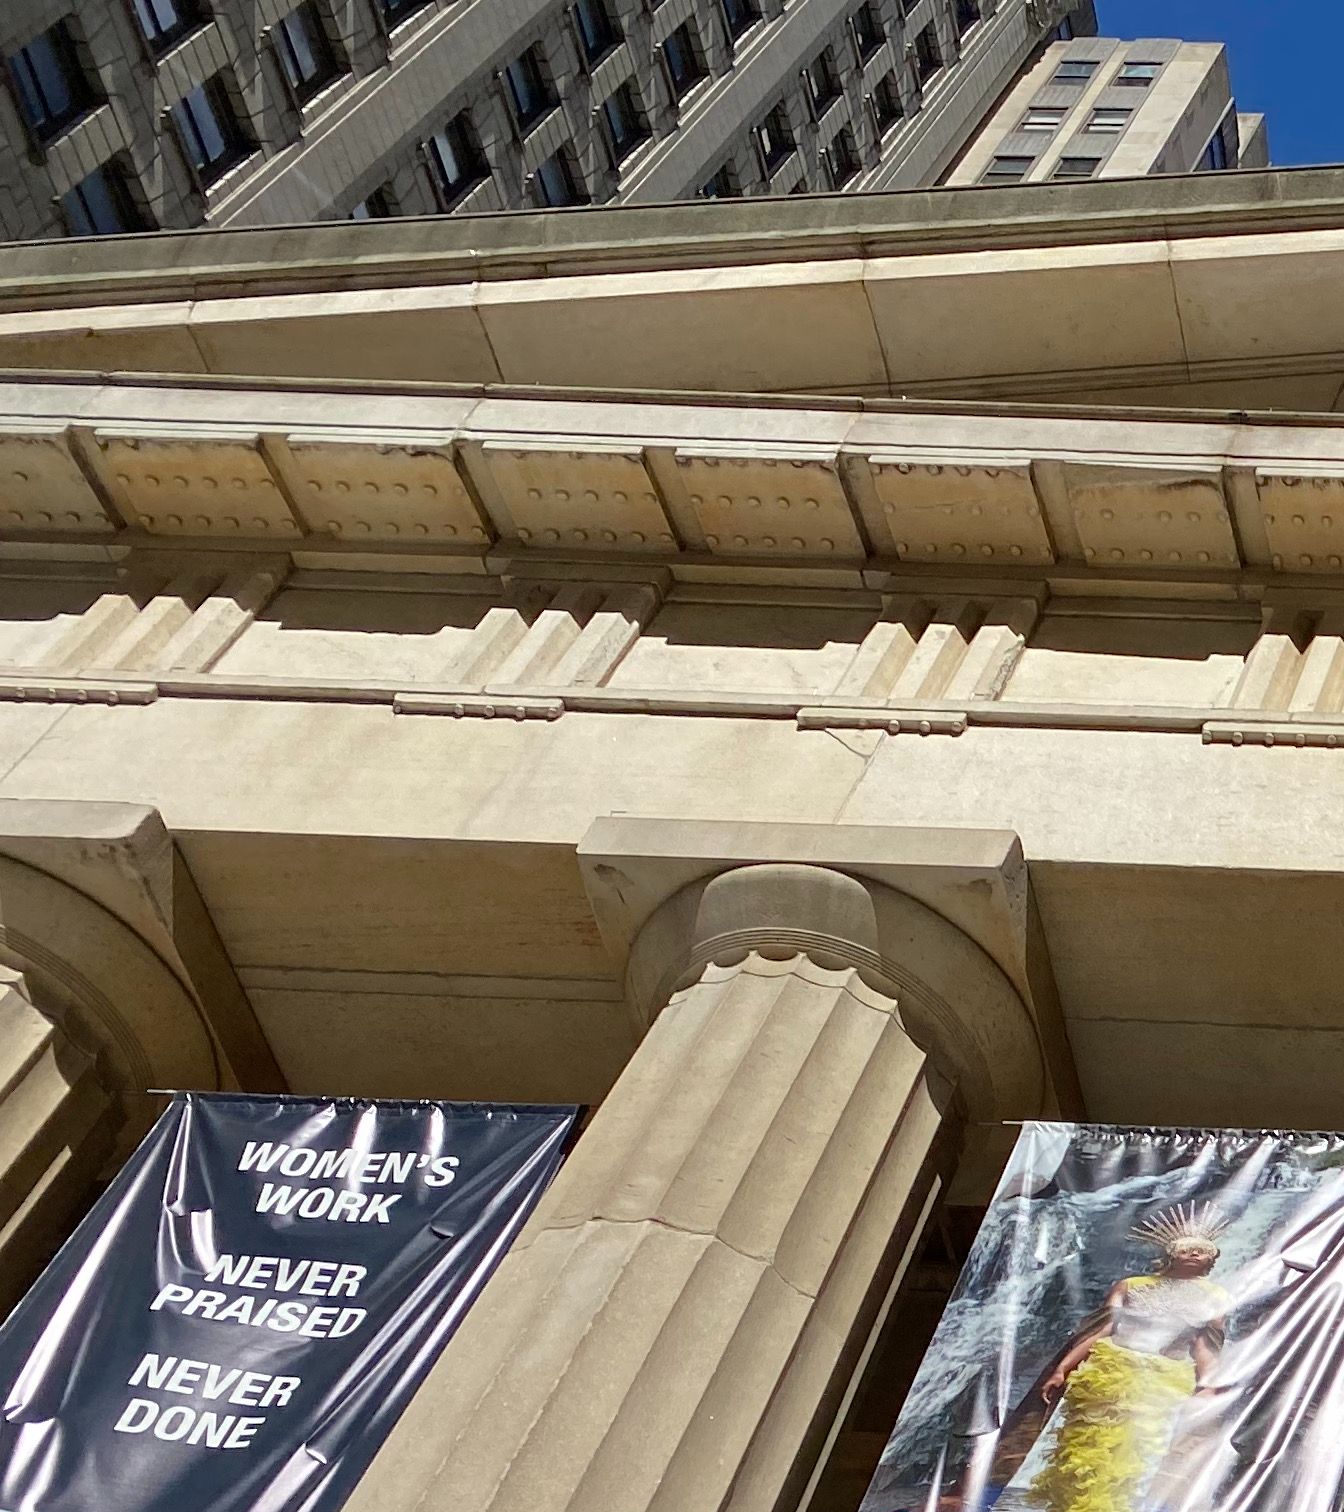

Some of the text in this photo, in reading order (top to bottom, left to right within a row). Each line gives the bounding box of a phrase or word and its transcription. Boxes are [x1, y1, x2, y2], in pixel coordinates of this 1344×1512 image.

[238, 1141, 460, 1187] WOMEN'S
[255, 1183, 402, 1223] WORK
[205, 1254, 368, 1298] NEVER
[150, 1283, 367, 1339] PRAISED
[128, 1353, 301, 1407] NEVER
[113, 1398, 266, 1449] DONE
